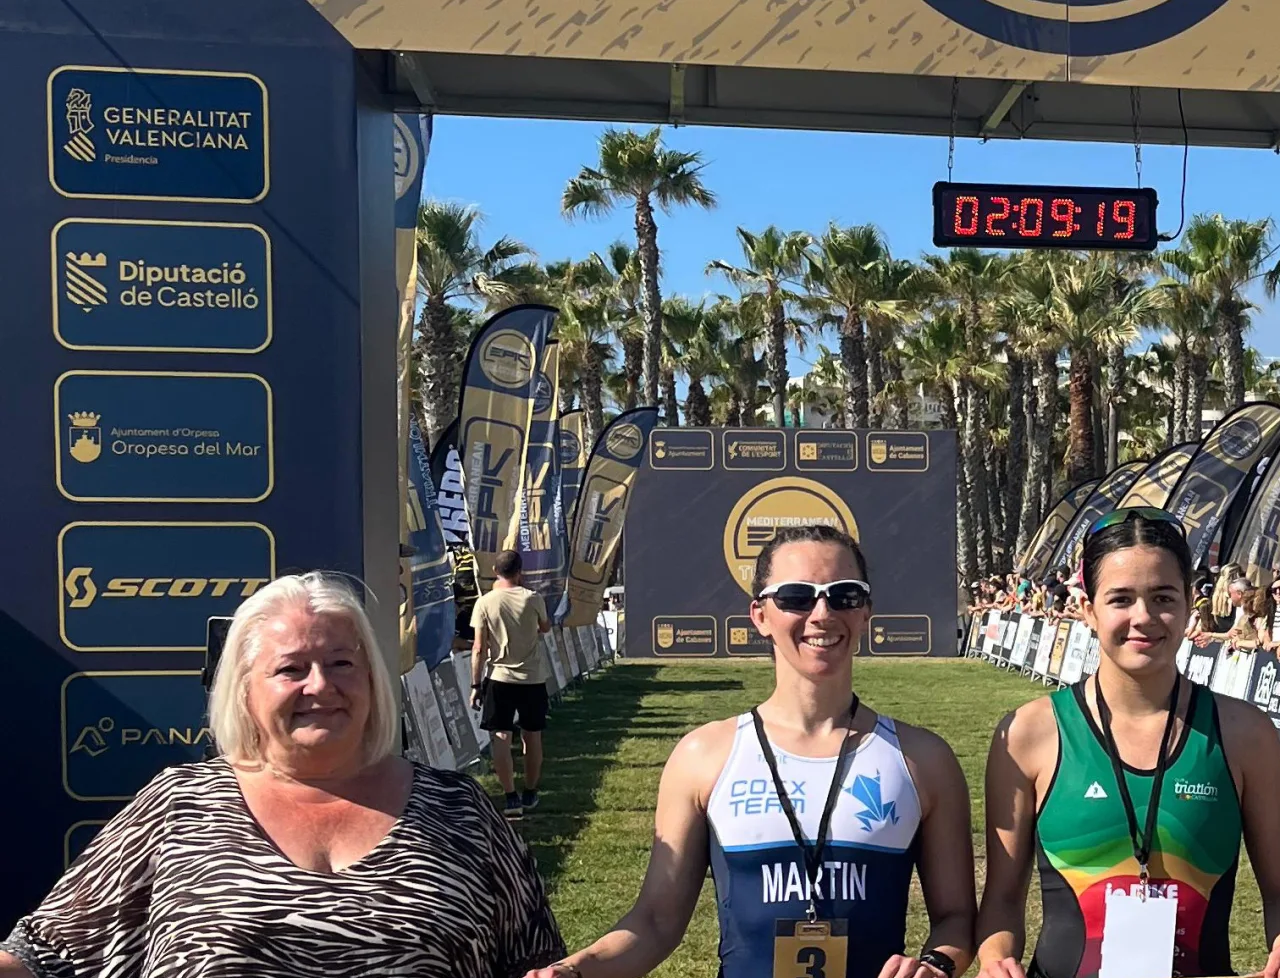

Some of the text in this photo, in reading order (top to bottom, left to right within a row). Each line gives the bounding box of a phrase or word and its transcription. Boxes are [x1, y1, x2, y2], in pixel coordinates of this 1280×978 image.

[104, 107, 251, 129] GENERALITAT
[106, 128, 249, 150] VALENCIANA
[104, 154, 158, 165] Presidencia
[954, 196, 1136, 239] 02:09:19
[119, 260, 246, 287] Diputació
[120, 287, 259, 310] de Castelló
[111, 427, 169, 439] Ajuntament
[111, 440, 261, 457] Oropesa del Mar
[889, 445, 924, 453] Ajuntament
[101, 577, 270, 597] SCOTT
[731, 779, 806, 797] COX
[1175, 780, 1218, 796] triatlón
[762, 861, 867, 903] MARTIN
